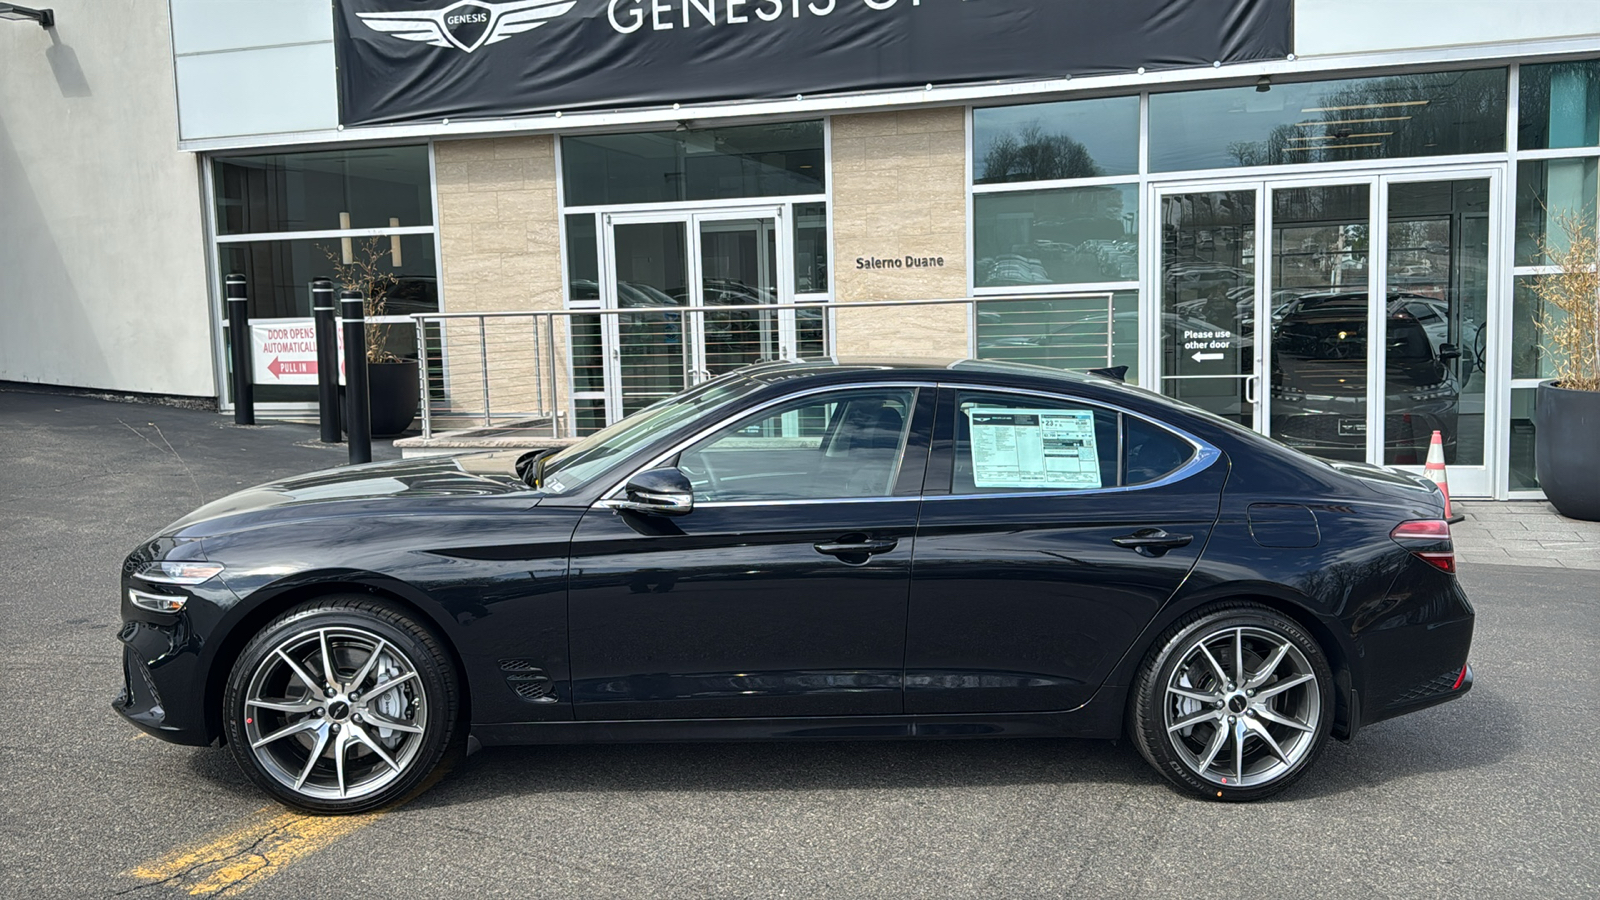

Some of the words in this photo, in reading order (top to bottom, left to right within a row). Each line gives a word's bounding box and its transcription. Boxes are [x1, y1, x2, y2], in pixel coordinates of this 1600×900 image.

[447, 13, 487, 25] GENESIS
[856, 256, 902, 269] Salerno
[905, 255, 944, 268] Duane
[267, 328, 289, 340] DOOR
[289, 327, 315, 339] OPENS
[1184, 330, 1213, 339] Please
[1214, 330, 1231, 338] use
[263, 341, 317, 353] AUTOMATICALL
[1184, 341, 1208, 349] other
[1209, 340, 1230, 349] door
[280, 363, 297, 373] PULL
[299, 363, 307, 372] IN
